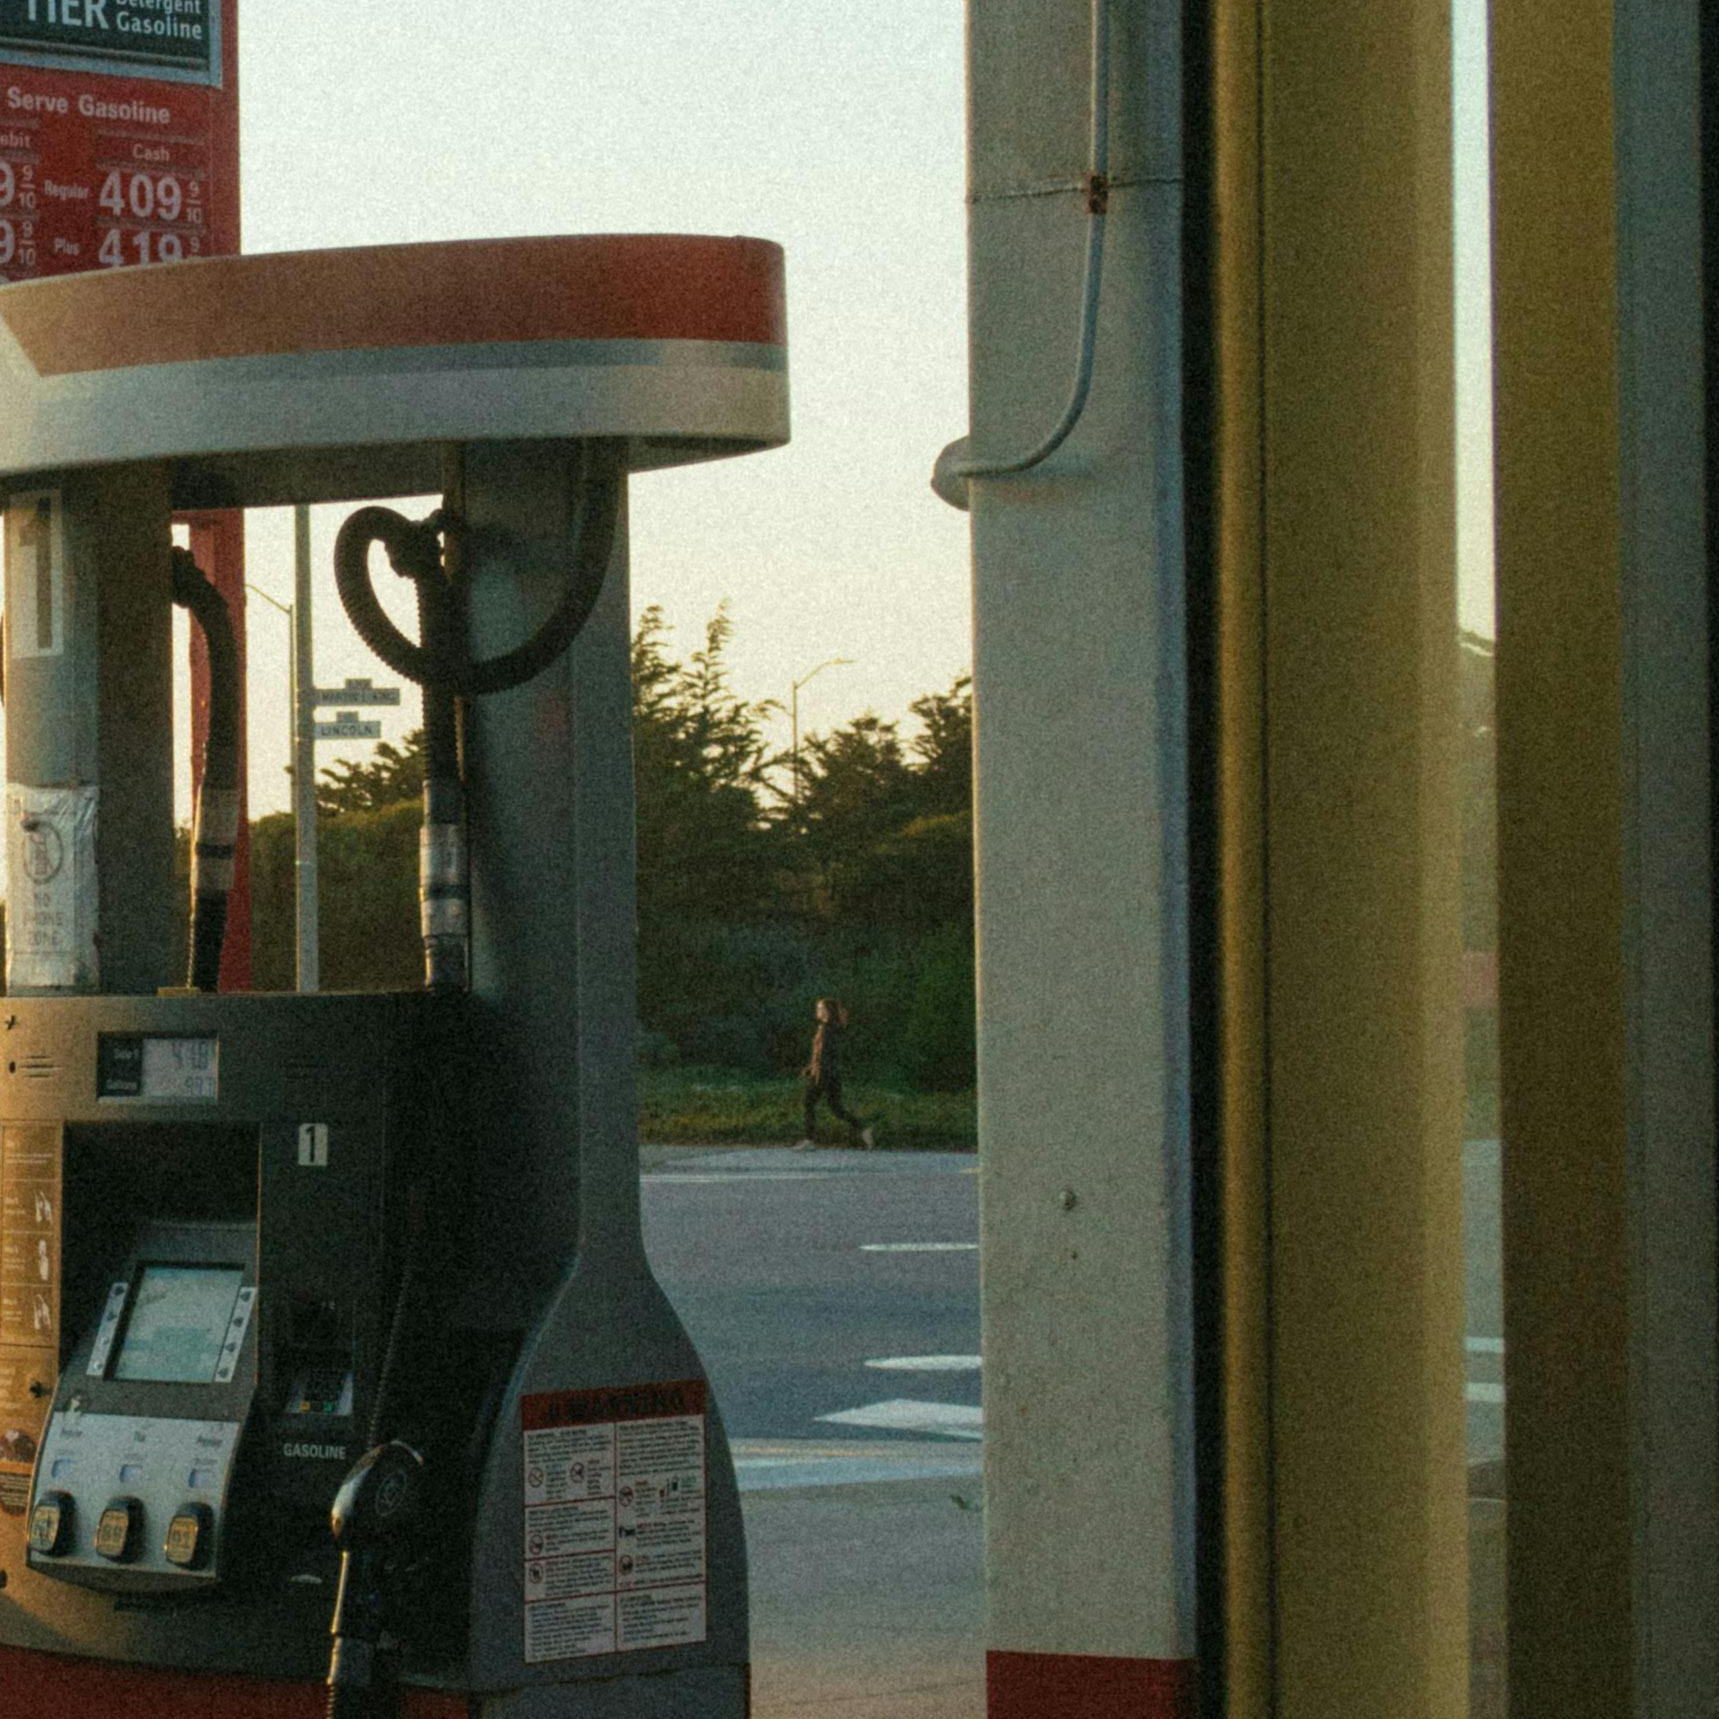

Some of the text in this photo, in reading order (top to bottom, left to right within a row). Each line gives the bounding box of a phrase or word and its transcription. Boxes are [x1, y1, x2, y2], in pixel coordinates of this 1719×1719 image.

[115, 10, 203, 42] Gasoline
[7, 87, 69, 115] Serve
[78, 94, 171, 125] Gasoline
[132, 144, 170, 162] Cash
[44, 179, 90, 201] Regular
[98, 171, 182, 221] 409
[53, 237, 81, 257] Plus
[320, 724, 373, 737] LINCOLN
[306, 1126, 318, 1163] 1
[283, 1442, 347, 1460] GASOLINE
